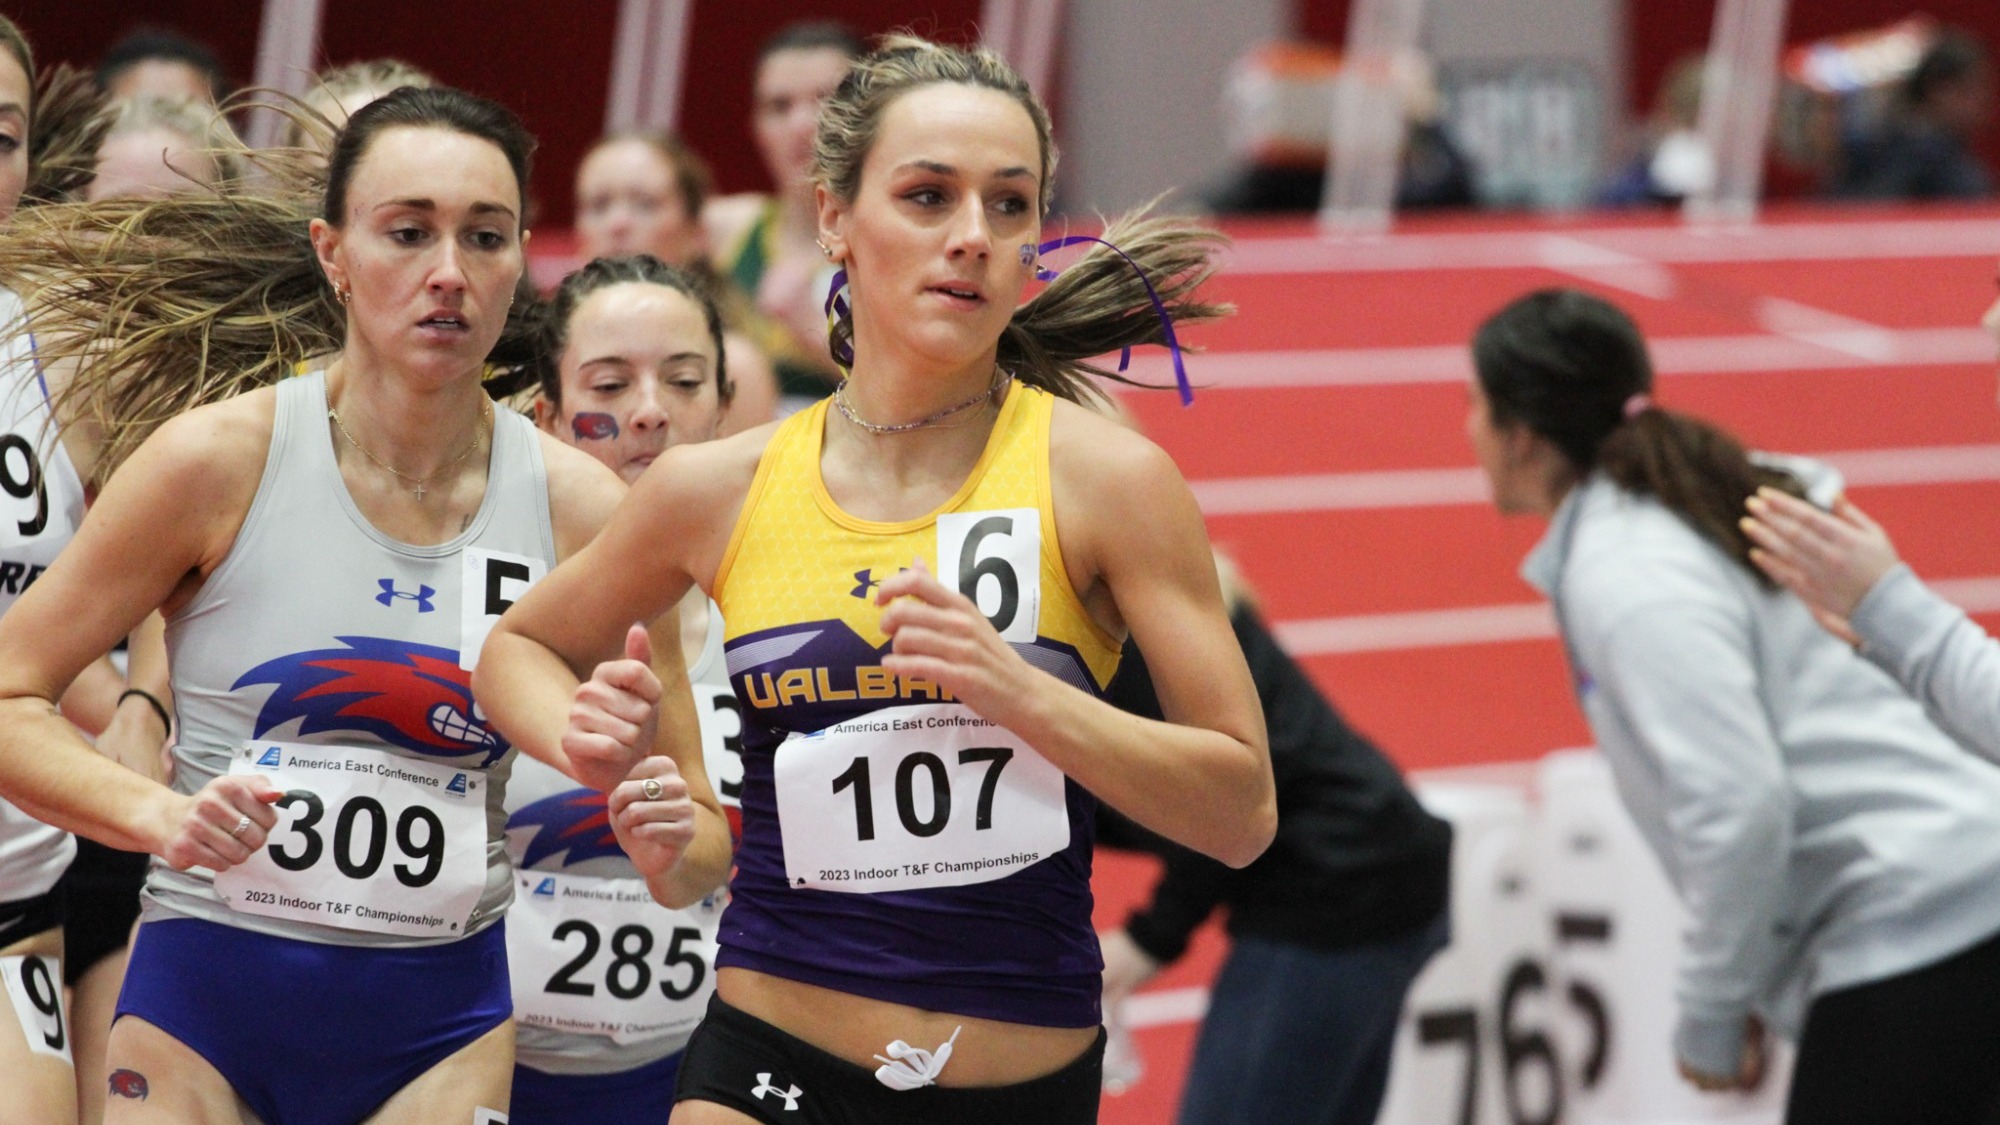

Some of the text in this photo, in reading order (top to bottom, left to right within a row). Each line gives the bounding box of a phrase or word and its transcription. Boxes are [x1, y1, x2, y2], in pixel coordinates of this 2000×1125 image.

[0, 433, 49, 537] 9
[958, 515, 1020, 634] 6
[287, 755, 440, 788] America East Conference
[833, 715, 999, 734] America East Conferen
[268, 788, 446, 888] 309
[832, 747, 1014, 842] 107
[244, 889, 445, 928] 2023 Indoor T&F Championships
[562, 885, 613, 901] America
[616, 890, 642, 903] East
[819, 850, 1040, 882] 2023 Indoor T&F Championships
[20, 955, 64, 1051] 9
[543, 918, 707, 1001] 285
[1418, 1009, 1480, 1125] 7
[1498, 960, 1564, 1125] 6
